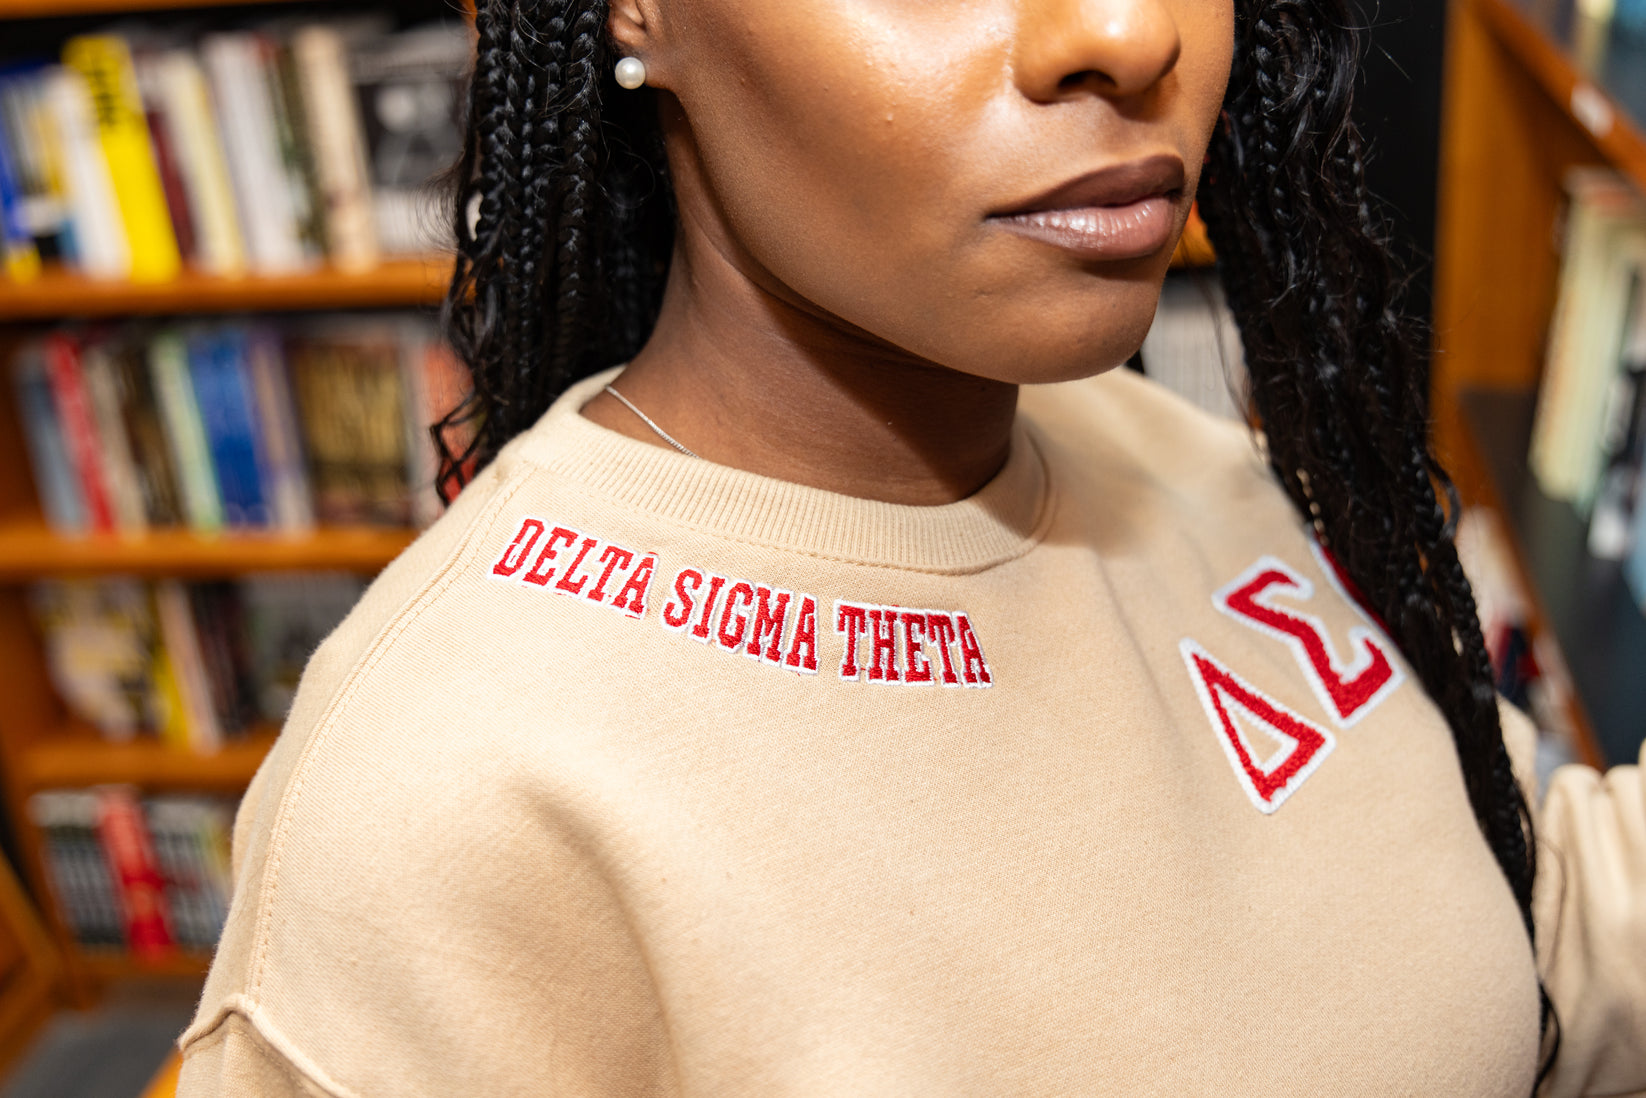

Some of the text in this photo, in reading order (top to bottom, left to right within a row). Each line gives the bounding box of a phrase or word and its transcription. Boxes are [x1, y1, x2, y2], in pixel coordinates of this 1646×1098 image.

[490, 516, 993, 687] DELTA SIGMA THETA
[1180, 528, 1405, 813] ΔΣ
